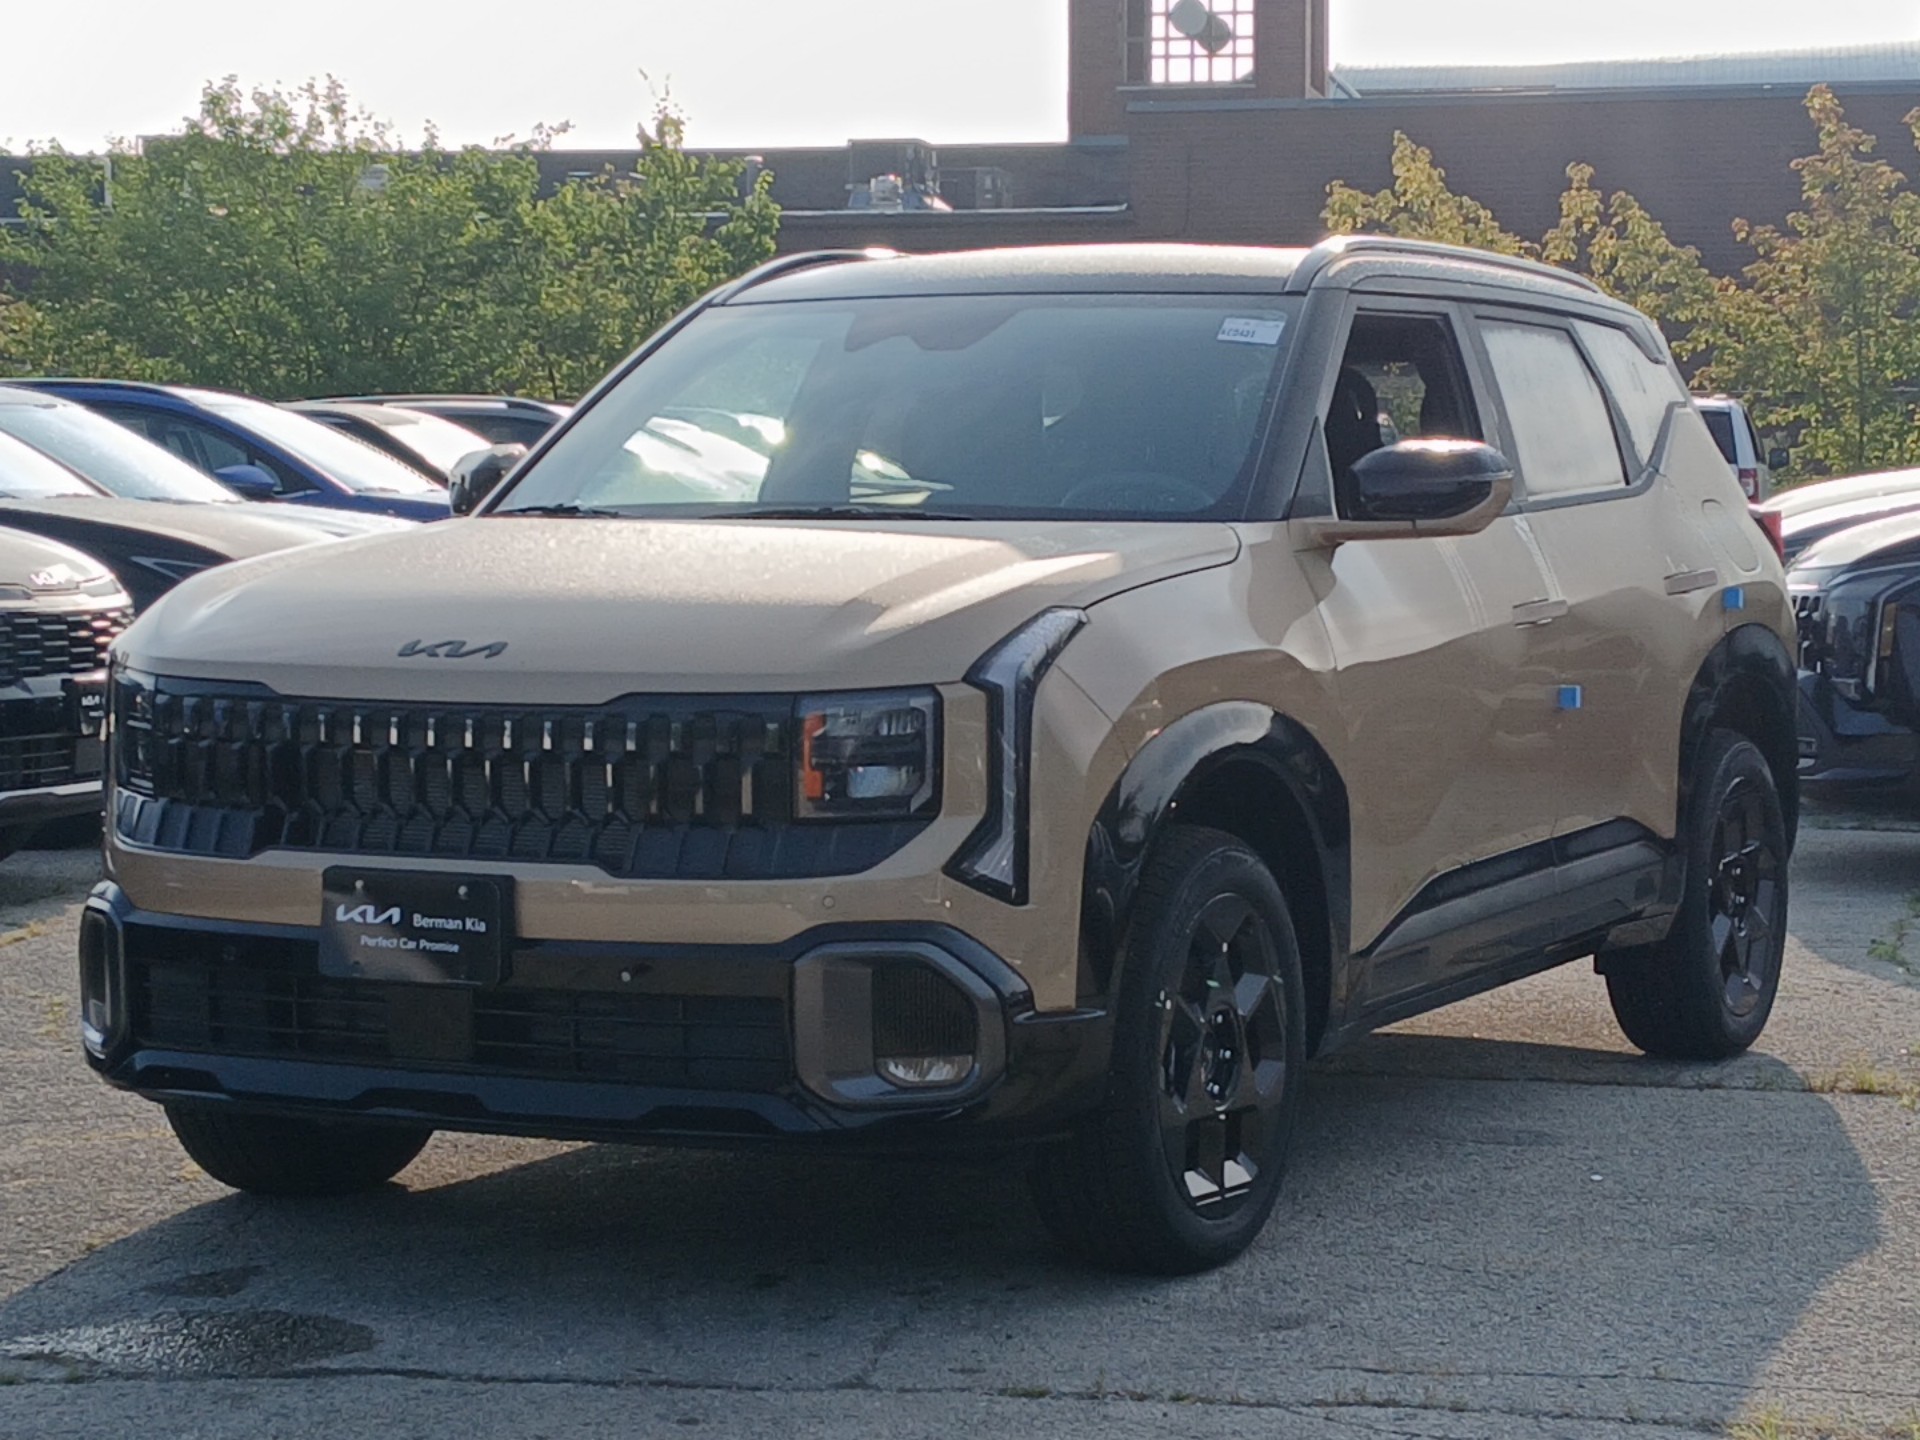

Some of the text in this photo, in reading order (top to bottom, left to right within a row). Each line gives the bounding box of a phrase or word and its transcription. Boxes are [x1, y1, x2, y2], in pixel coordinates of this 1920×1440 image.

[413, 914, 462, 930] Berman
[465, 917, 486, 933] Kia
[361, 935, 460, 953] Perfect Car Promise
